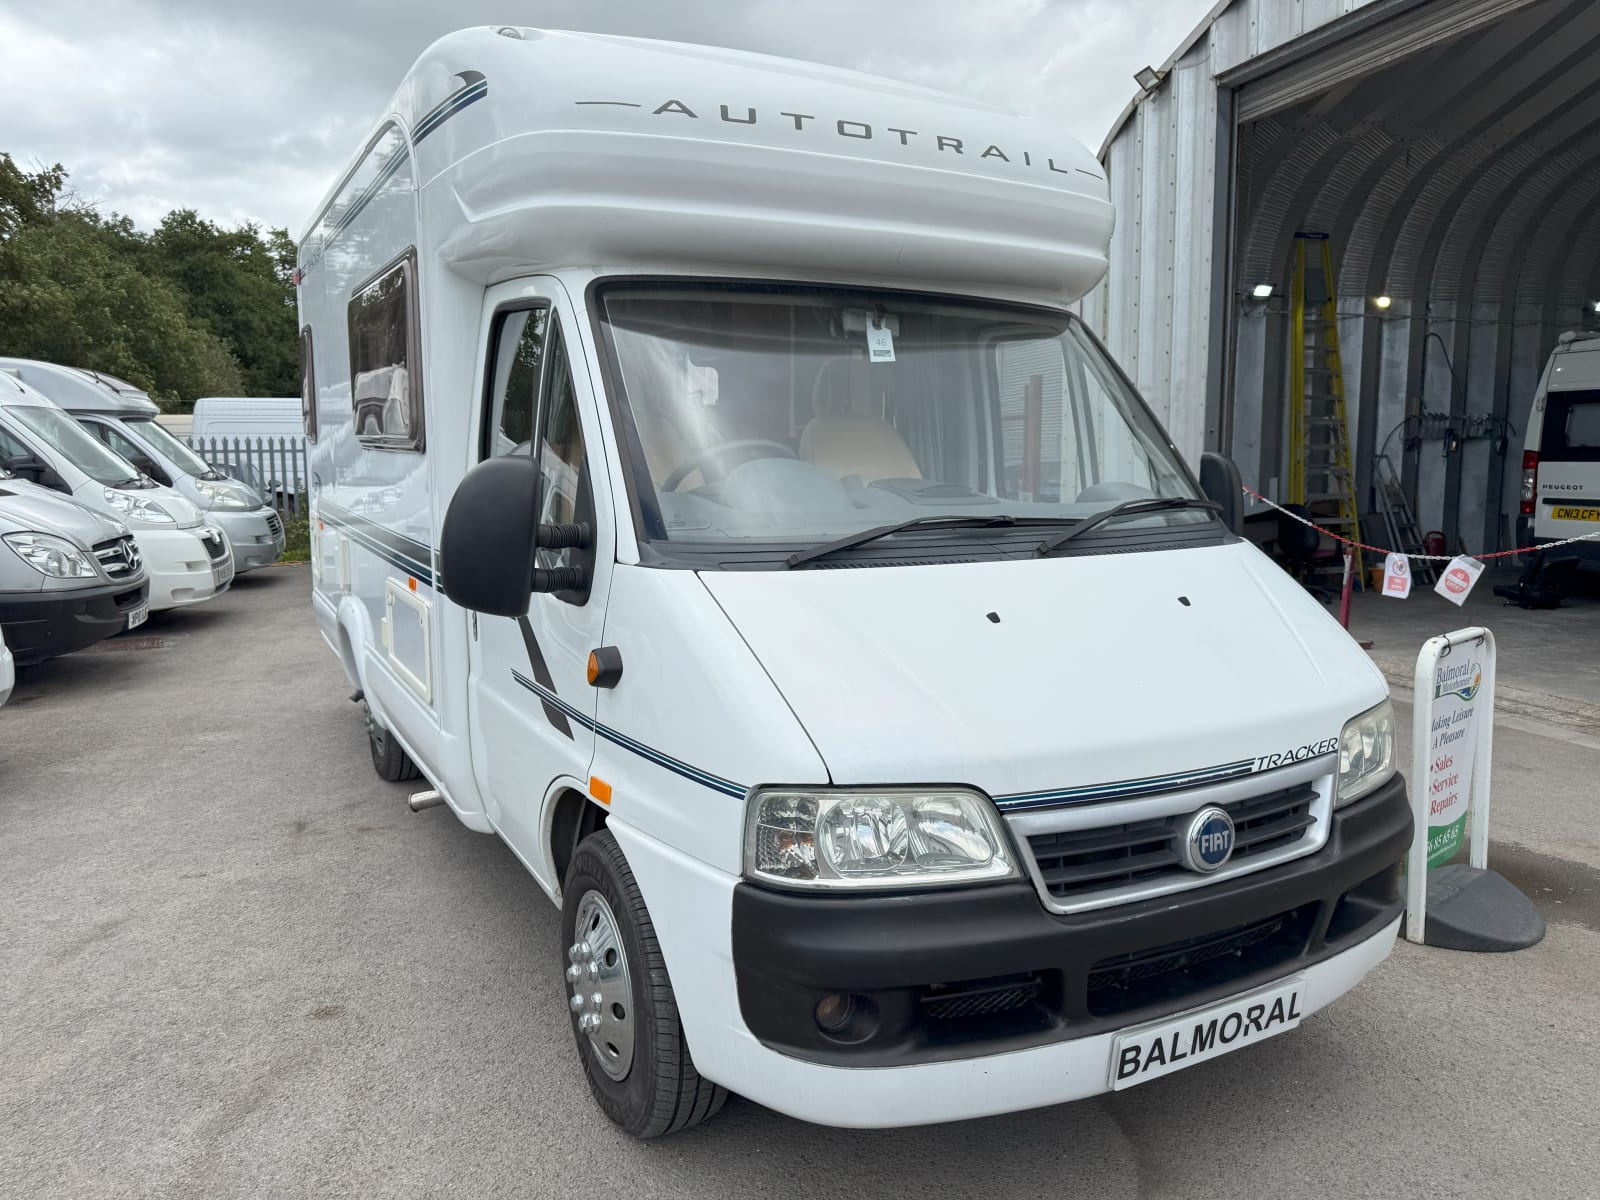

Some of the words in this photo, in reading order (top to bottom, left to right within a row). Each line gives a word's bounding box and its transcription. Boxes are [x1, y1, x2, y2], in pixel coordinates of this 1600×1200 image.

[652, 99, 1068, 175] AUTOTRAIL
[875, 338, 887, 347] 46
[1542, 483, 1584, 491] PEUGEOT
[1557, 508, 1580, 519] CN13
[1436, 658, 1470, 683] Balmoral
[1451, 707, 1474, 724] Leisure
[1432, 736, 1438, 750] A
[1439, 728, 1466, 747] Pleasure
[1256, 737, 1338, 771] TRACKER
[1434, 754, 1454, 774] Sales
[1431, 772, 1459, 795] Service
[1430, 791, 1458, 816] Repairs
[1200, 829, 1230, 854] FIAT
[1117, 991, 1301, 1081] BALMORAL
